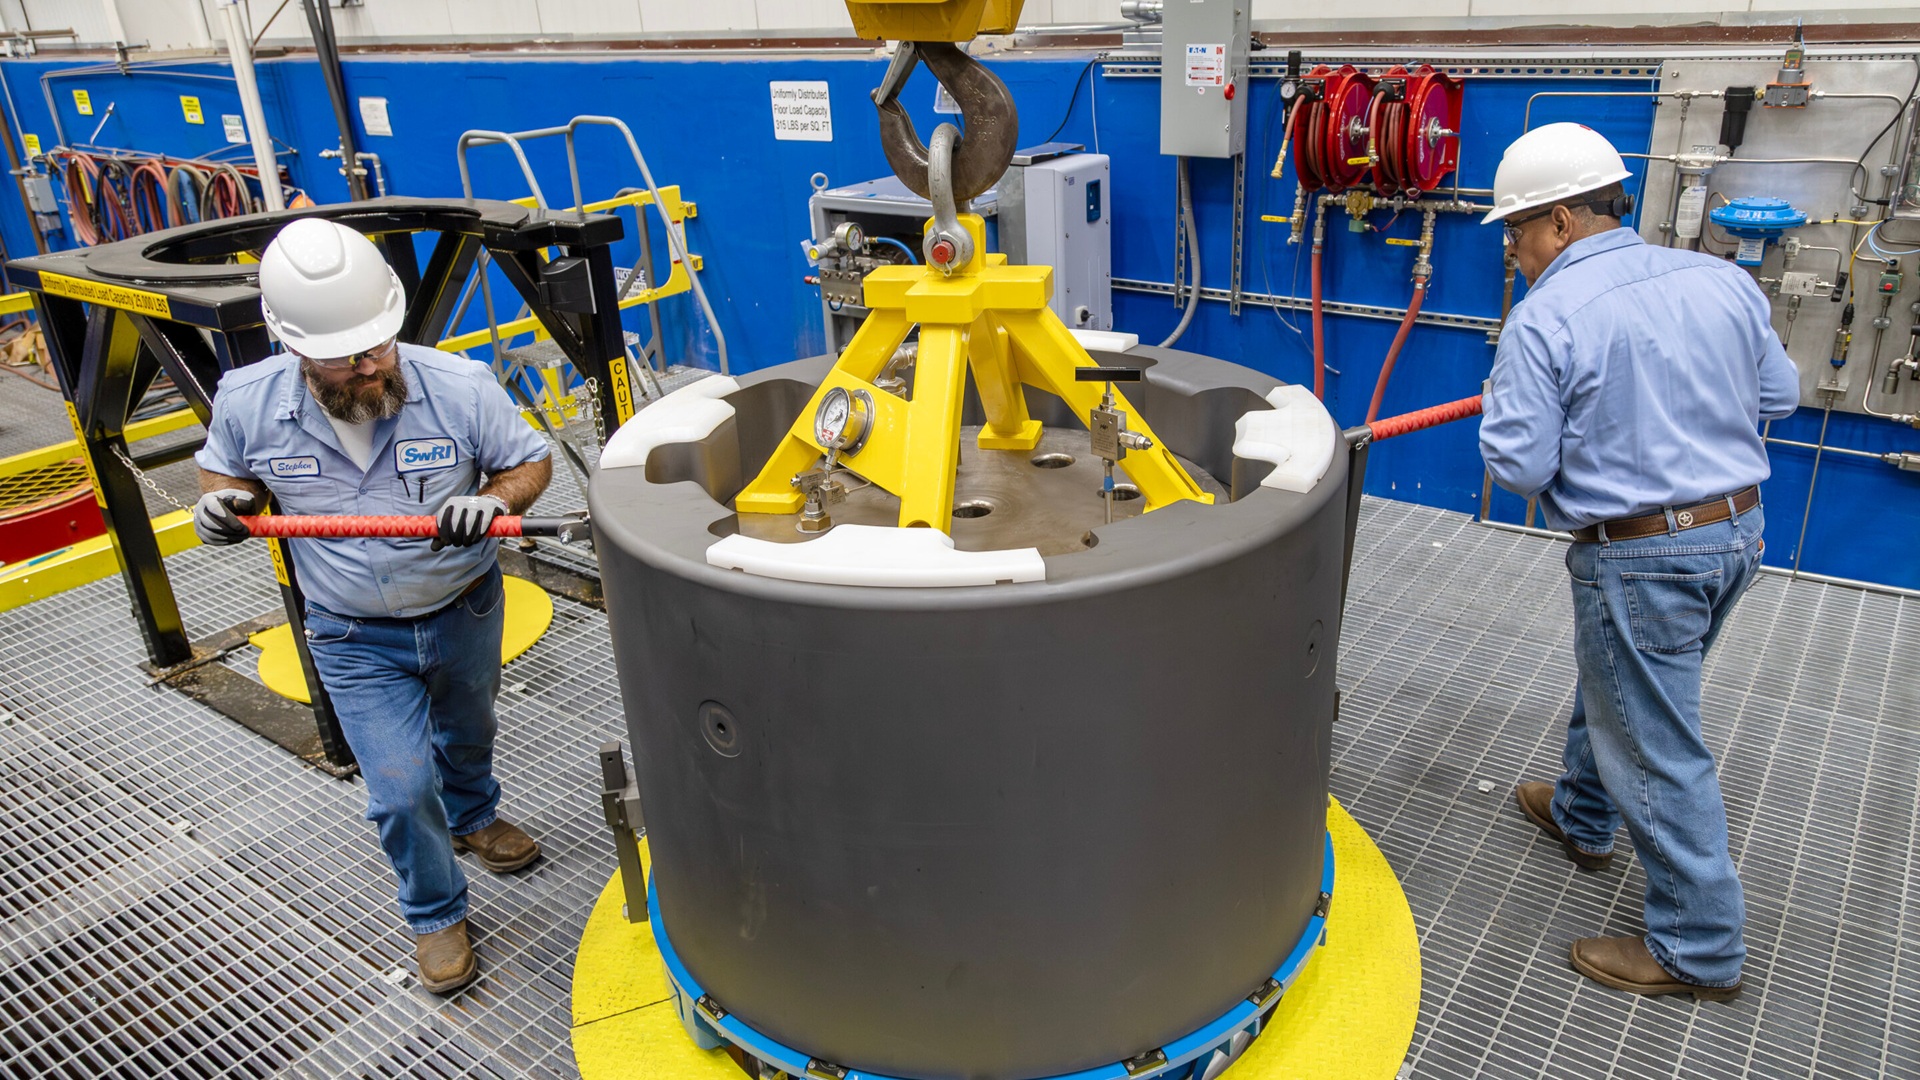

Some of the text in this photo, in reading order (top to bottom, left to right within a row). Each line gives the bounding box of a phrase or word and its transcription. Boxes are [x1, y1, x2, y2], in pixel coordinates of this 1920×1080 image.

[772, 88, 828, 101] Uniformly Distributed
[774, 103, 828, 118] Floor Load Capacity
[776, 119, 786, 130] 315
[787, 119, 799, 131] LBS
[800, 122, 809, 133] per
[822, 121, 830, 131] FT
[616, 269, 646, 283] NOE
[65, 279, 96, 299] Distributed
[94, 285, 110, 302] Load
[108, 288, 135, 309] Capacity
[153, 296, 168, 313] LBS
[404, 445, 452, 463] SwRI
[277, 460, 312, 473] Stephen
